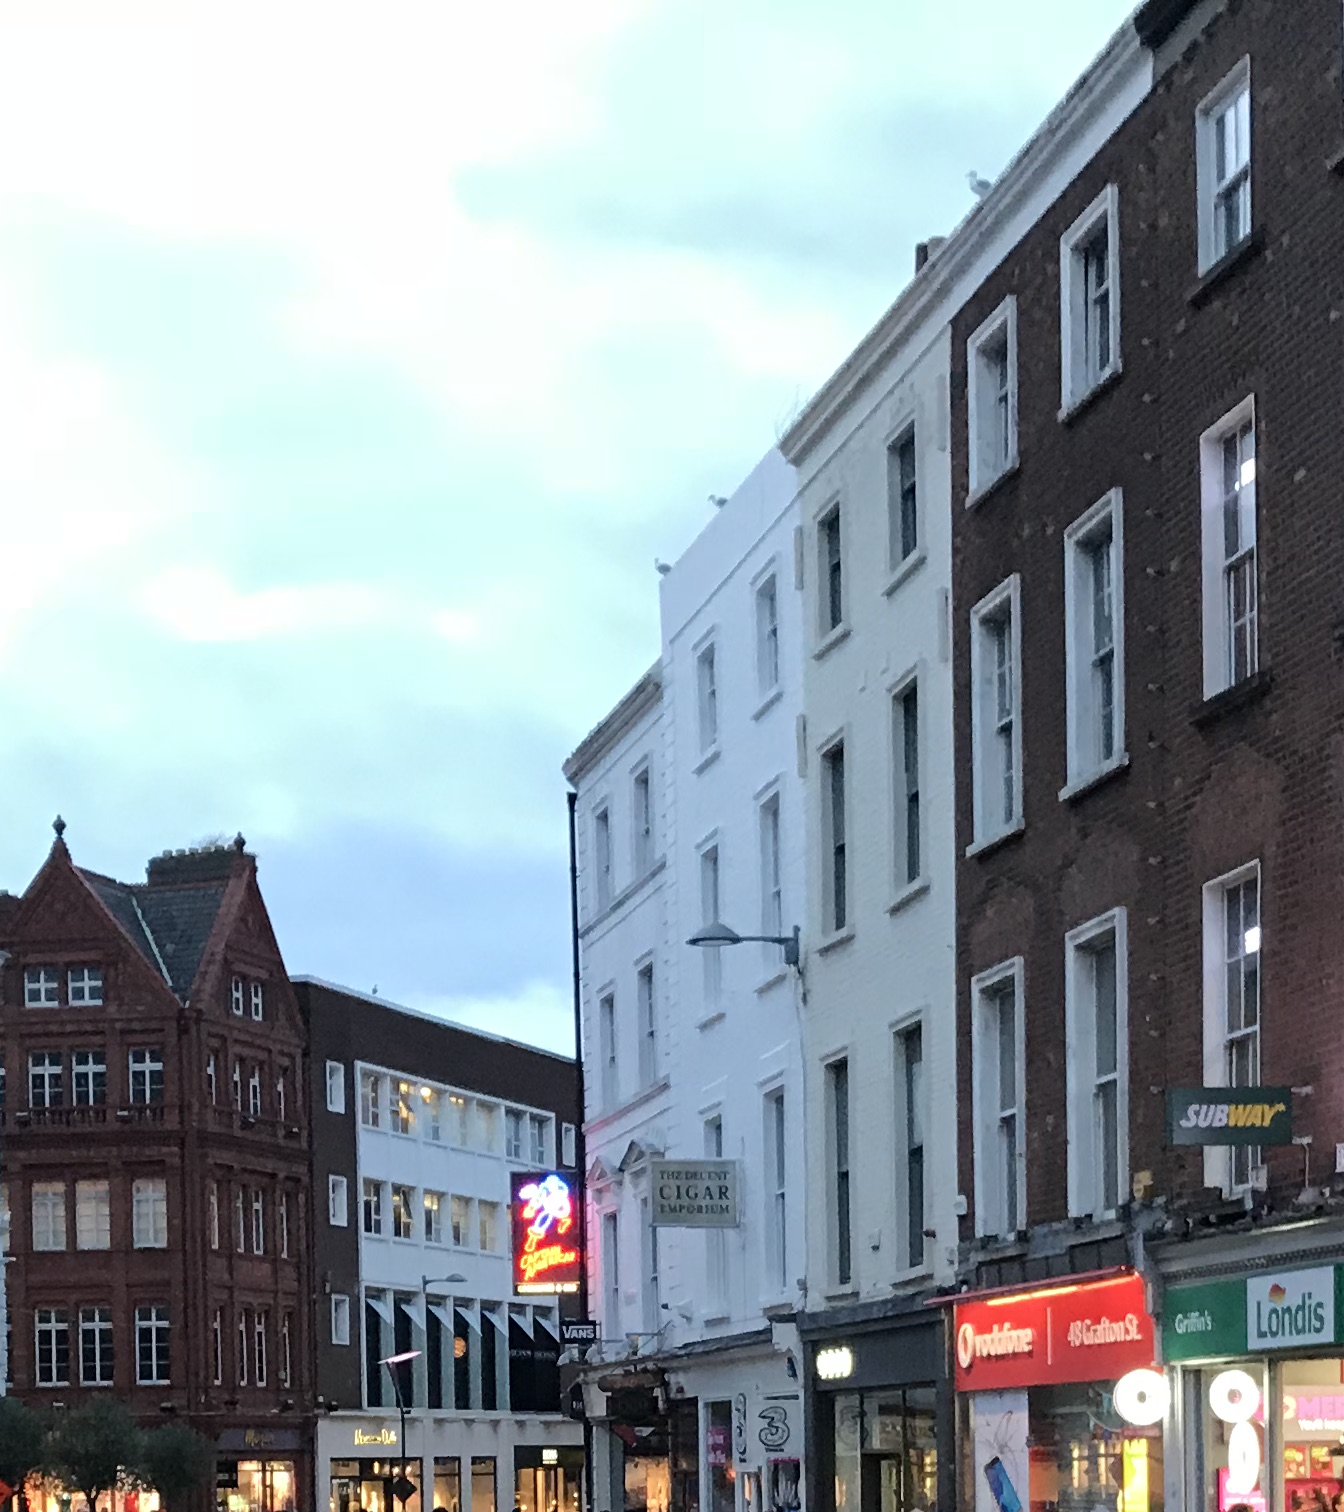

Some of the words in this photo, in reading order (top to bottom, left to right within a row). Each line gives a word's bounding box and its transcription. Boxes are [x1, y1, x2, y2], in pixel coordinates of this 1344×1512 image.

[1179, 1102, 1286, 1128] SUBWAY
[659, 1184, 730, 1201] CIGAR
[659, 1203, 730, 1215] EMPORIUM
[1255, 1291, 1325, 1339] Londis
[561, 1325, 595, 1340] VANS
[973, 1322, 1033, 1358] vodafone
[1083, 1316, 1124, 1346] Grafton
